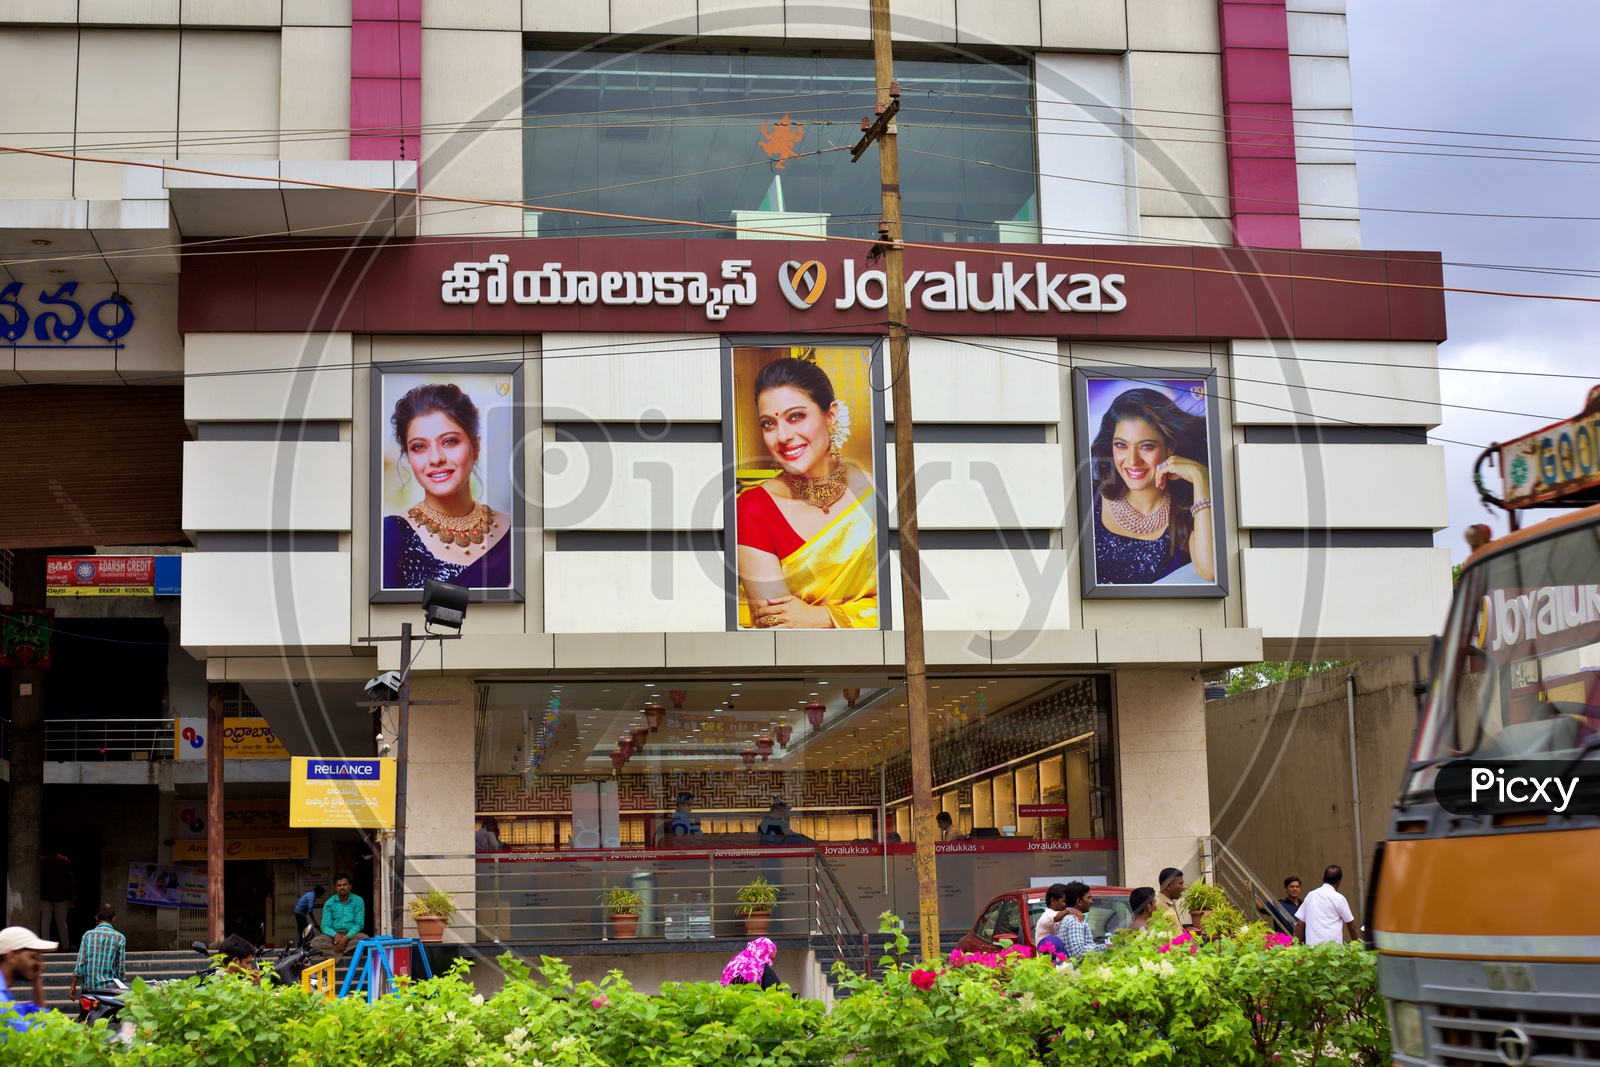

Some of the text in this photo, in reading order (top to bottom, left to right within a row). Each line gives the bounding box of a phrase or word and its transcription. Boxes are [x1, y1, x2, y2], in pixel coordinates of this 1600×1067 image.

[835, 258, 1127, 313] Joyalukkas
[98, 560, 152, 573] ADARSH CREDIT
[188, 844, 208, 853] Any
[254, 844, 298, 854] Banking
[824, 846, 870, 855] Joyalukkas
[1027, 841, 1072, 850] Joyalukkas
